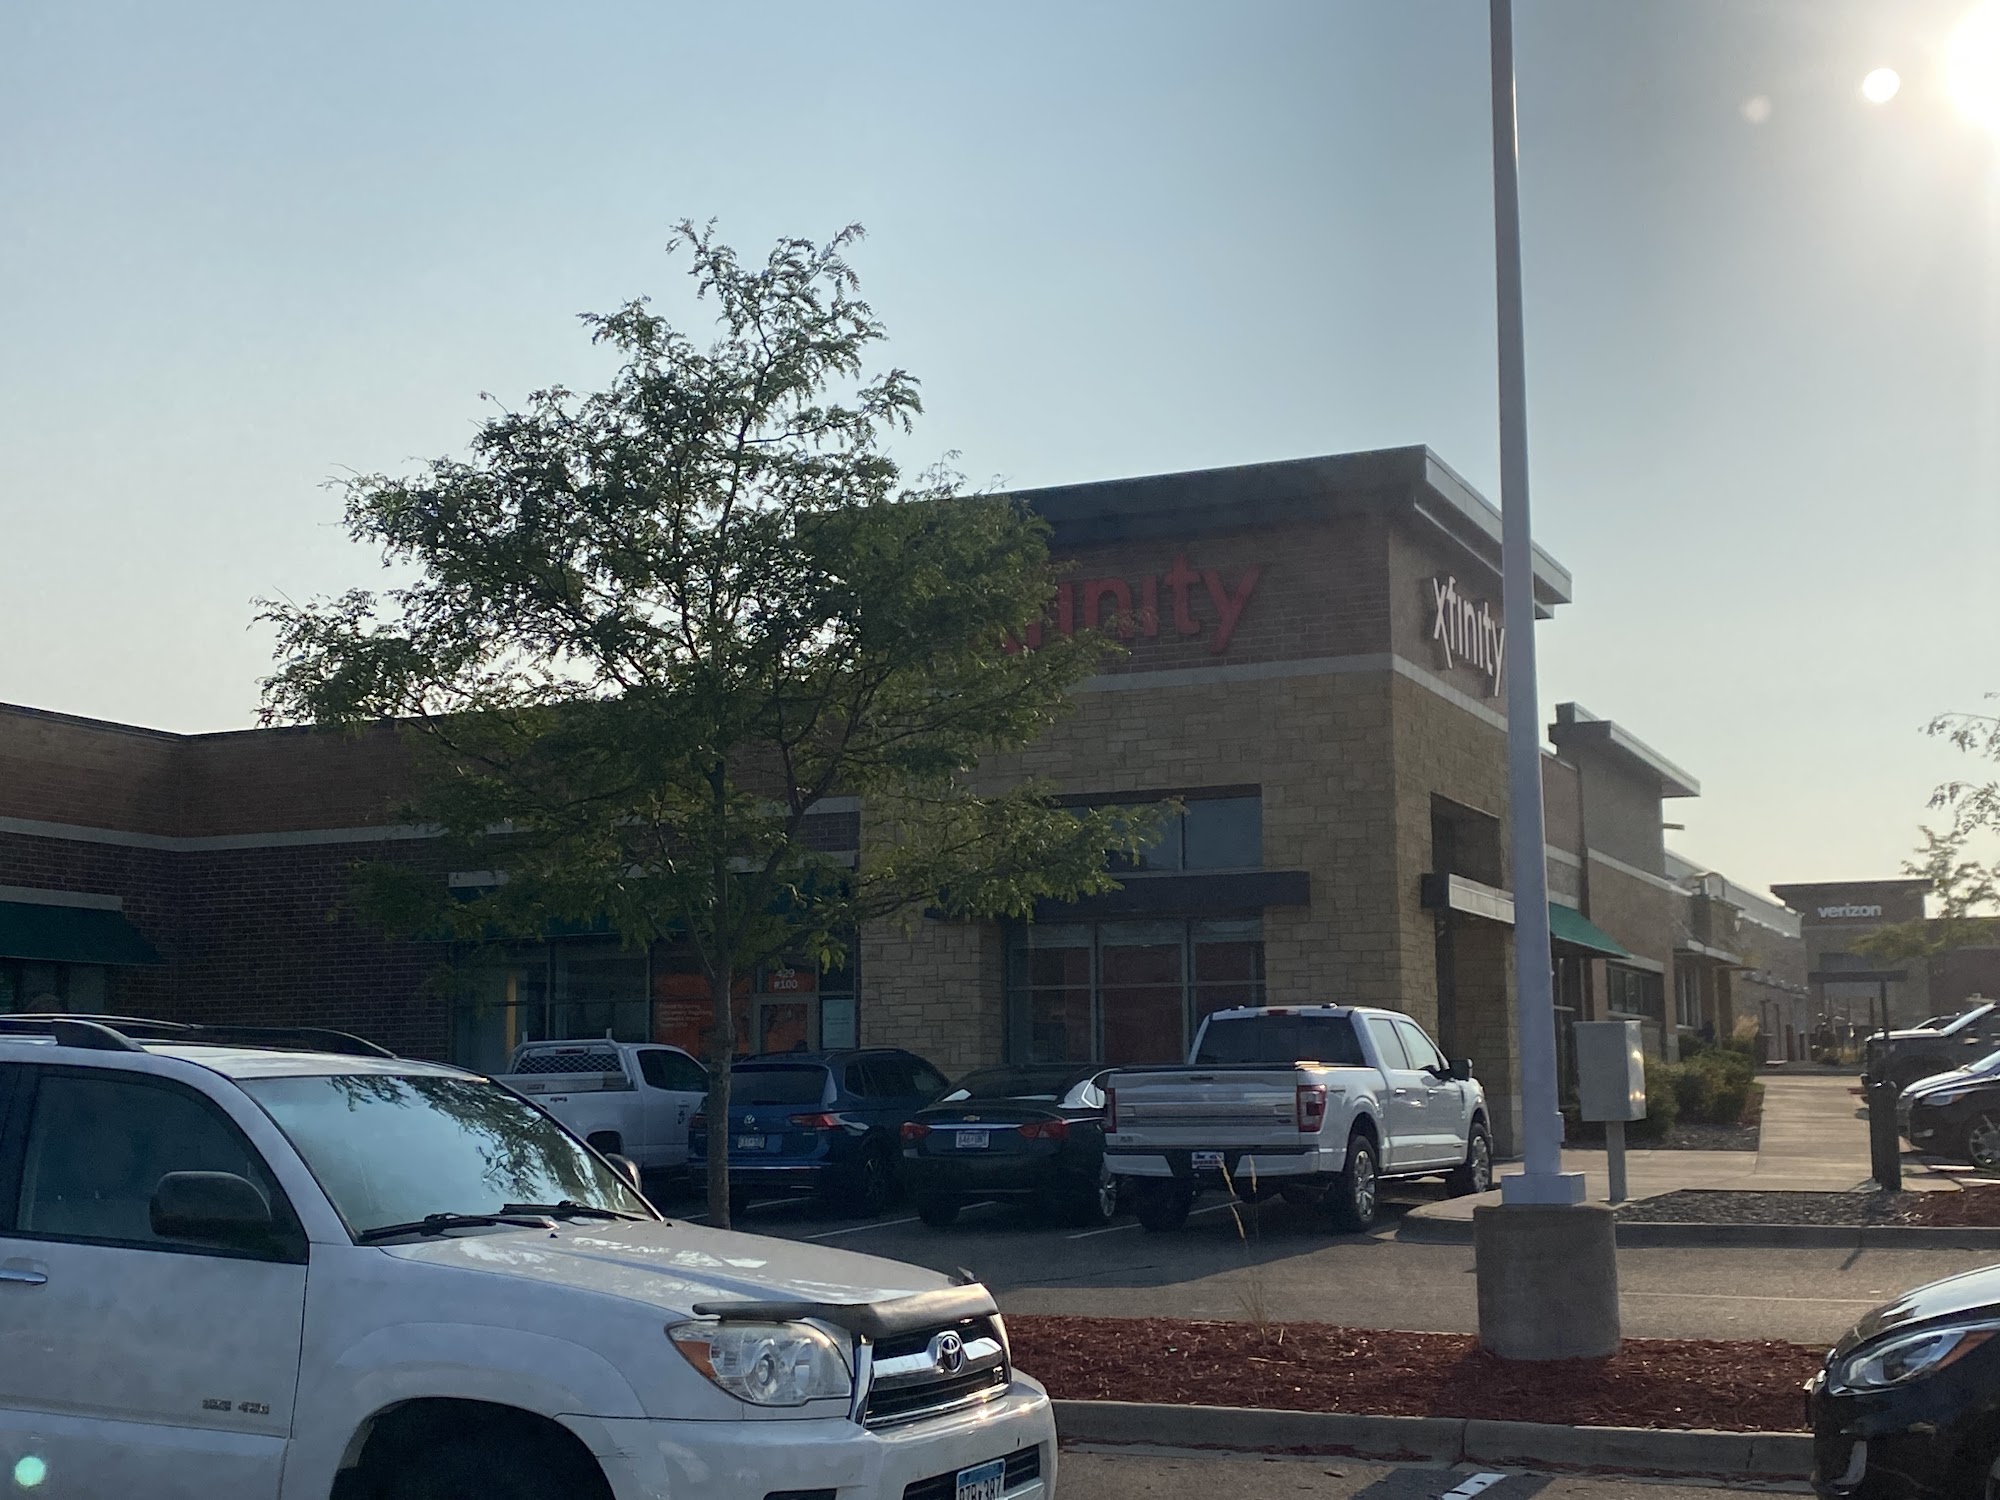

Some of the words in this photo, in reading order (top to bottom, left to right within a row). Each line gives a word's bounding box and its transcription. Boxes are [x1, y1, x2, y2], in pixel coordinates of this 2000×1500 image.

[1003, 554, 1262, 655] inity
[1433, 576, 1504, 697] xfinity
[1817, 902, 1882, 918] verizon
[773, 979, 798, 989] #100
